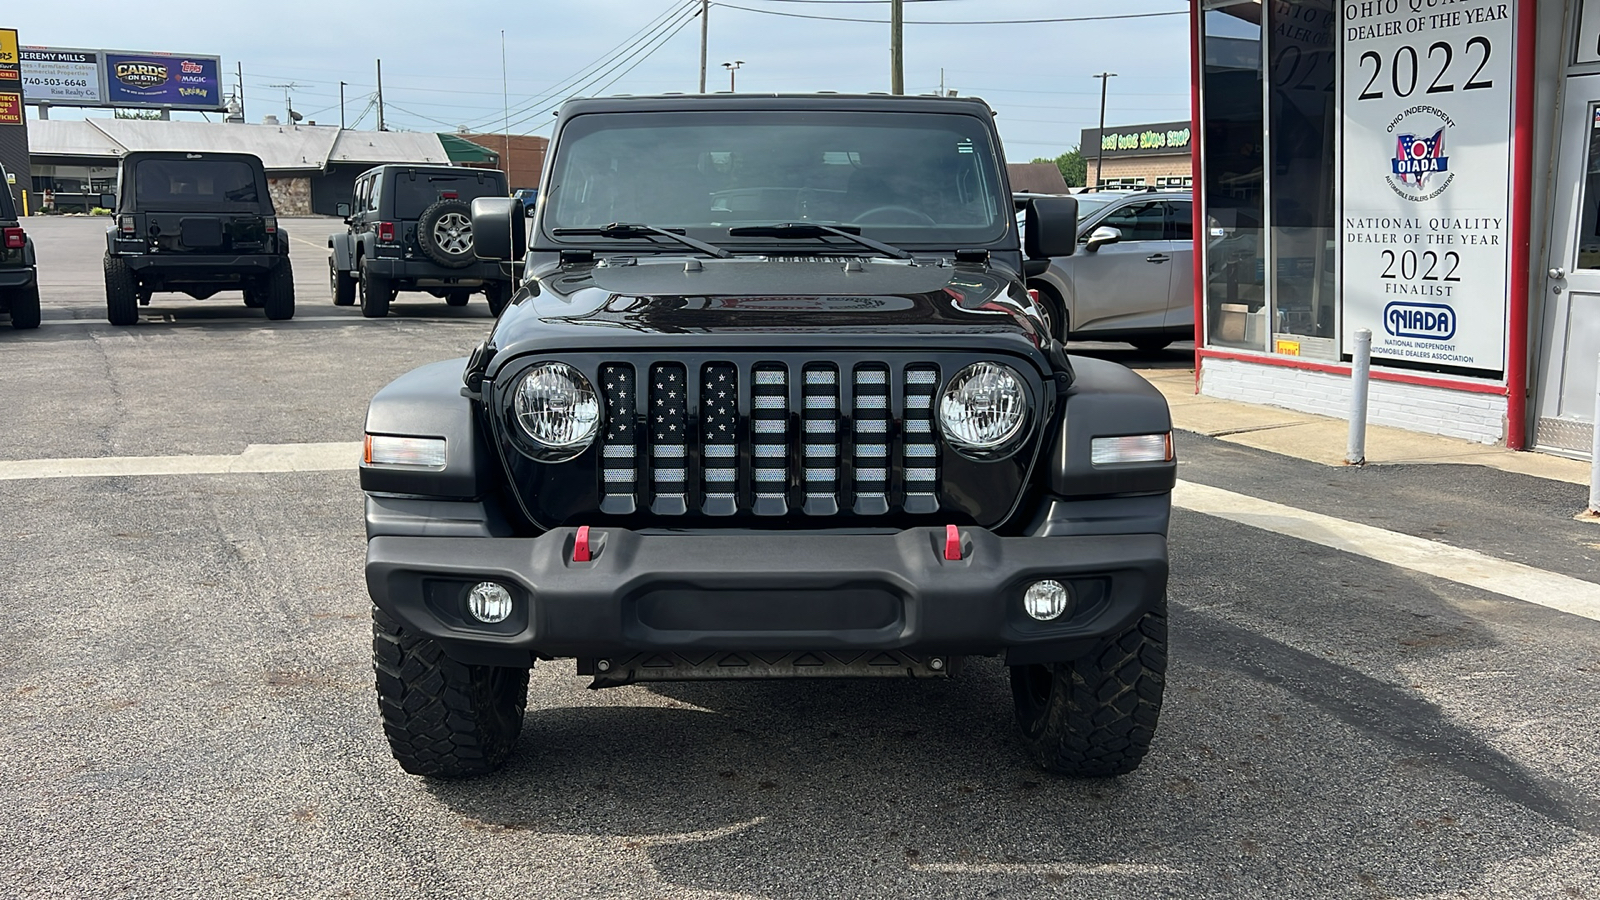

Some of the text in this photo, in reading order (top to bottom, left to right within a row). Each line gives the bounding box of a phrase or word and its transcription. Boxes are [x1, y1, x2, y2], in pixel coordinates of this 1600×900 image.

[1346, 0, 1398, 20] OHIO
[1348, 20, 1402, 42] DEALER
[1406, 16, 1426, 33] OF
[1429, 12, 1460, 29] THE
[1465, 4, 1508, 24] YEAR
[20, 52, 57, 60] JEREMY
[117, 64, 167, 78] CARDS
[1358, 36, 1493, 101] 2022
[23, 78, 86, 87] 740-503-6648
[66, 89, 84, 97] Realty
[1386, 105, 1456, 133] OHIO INDEPENDENT
[1167, 128, 1190, 147] SHOP
[1398, 158, 1438, 172] OIADA
[1385, 175, 1408, 200] AUTOMOBILE
[1429, 172, 1455, 199] ASSOCIATION
[1346, 218, 1502, 231] NATIONAL QUALITY
[1347, 233, 1499, 245] DEALER OF THE YEAR
[1380, 249, 1461, 282] 2022
[1386, 283, 1453, 296] FINALIST
[1390, 309, 1448, 333] NIADA
[1385, 339, 1456, 351] NATIONAL INDEPENDENT
[1405, 350, 1430, 359] DEALERS
[1432, 353, 1474, 363] ASSOCIATION
